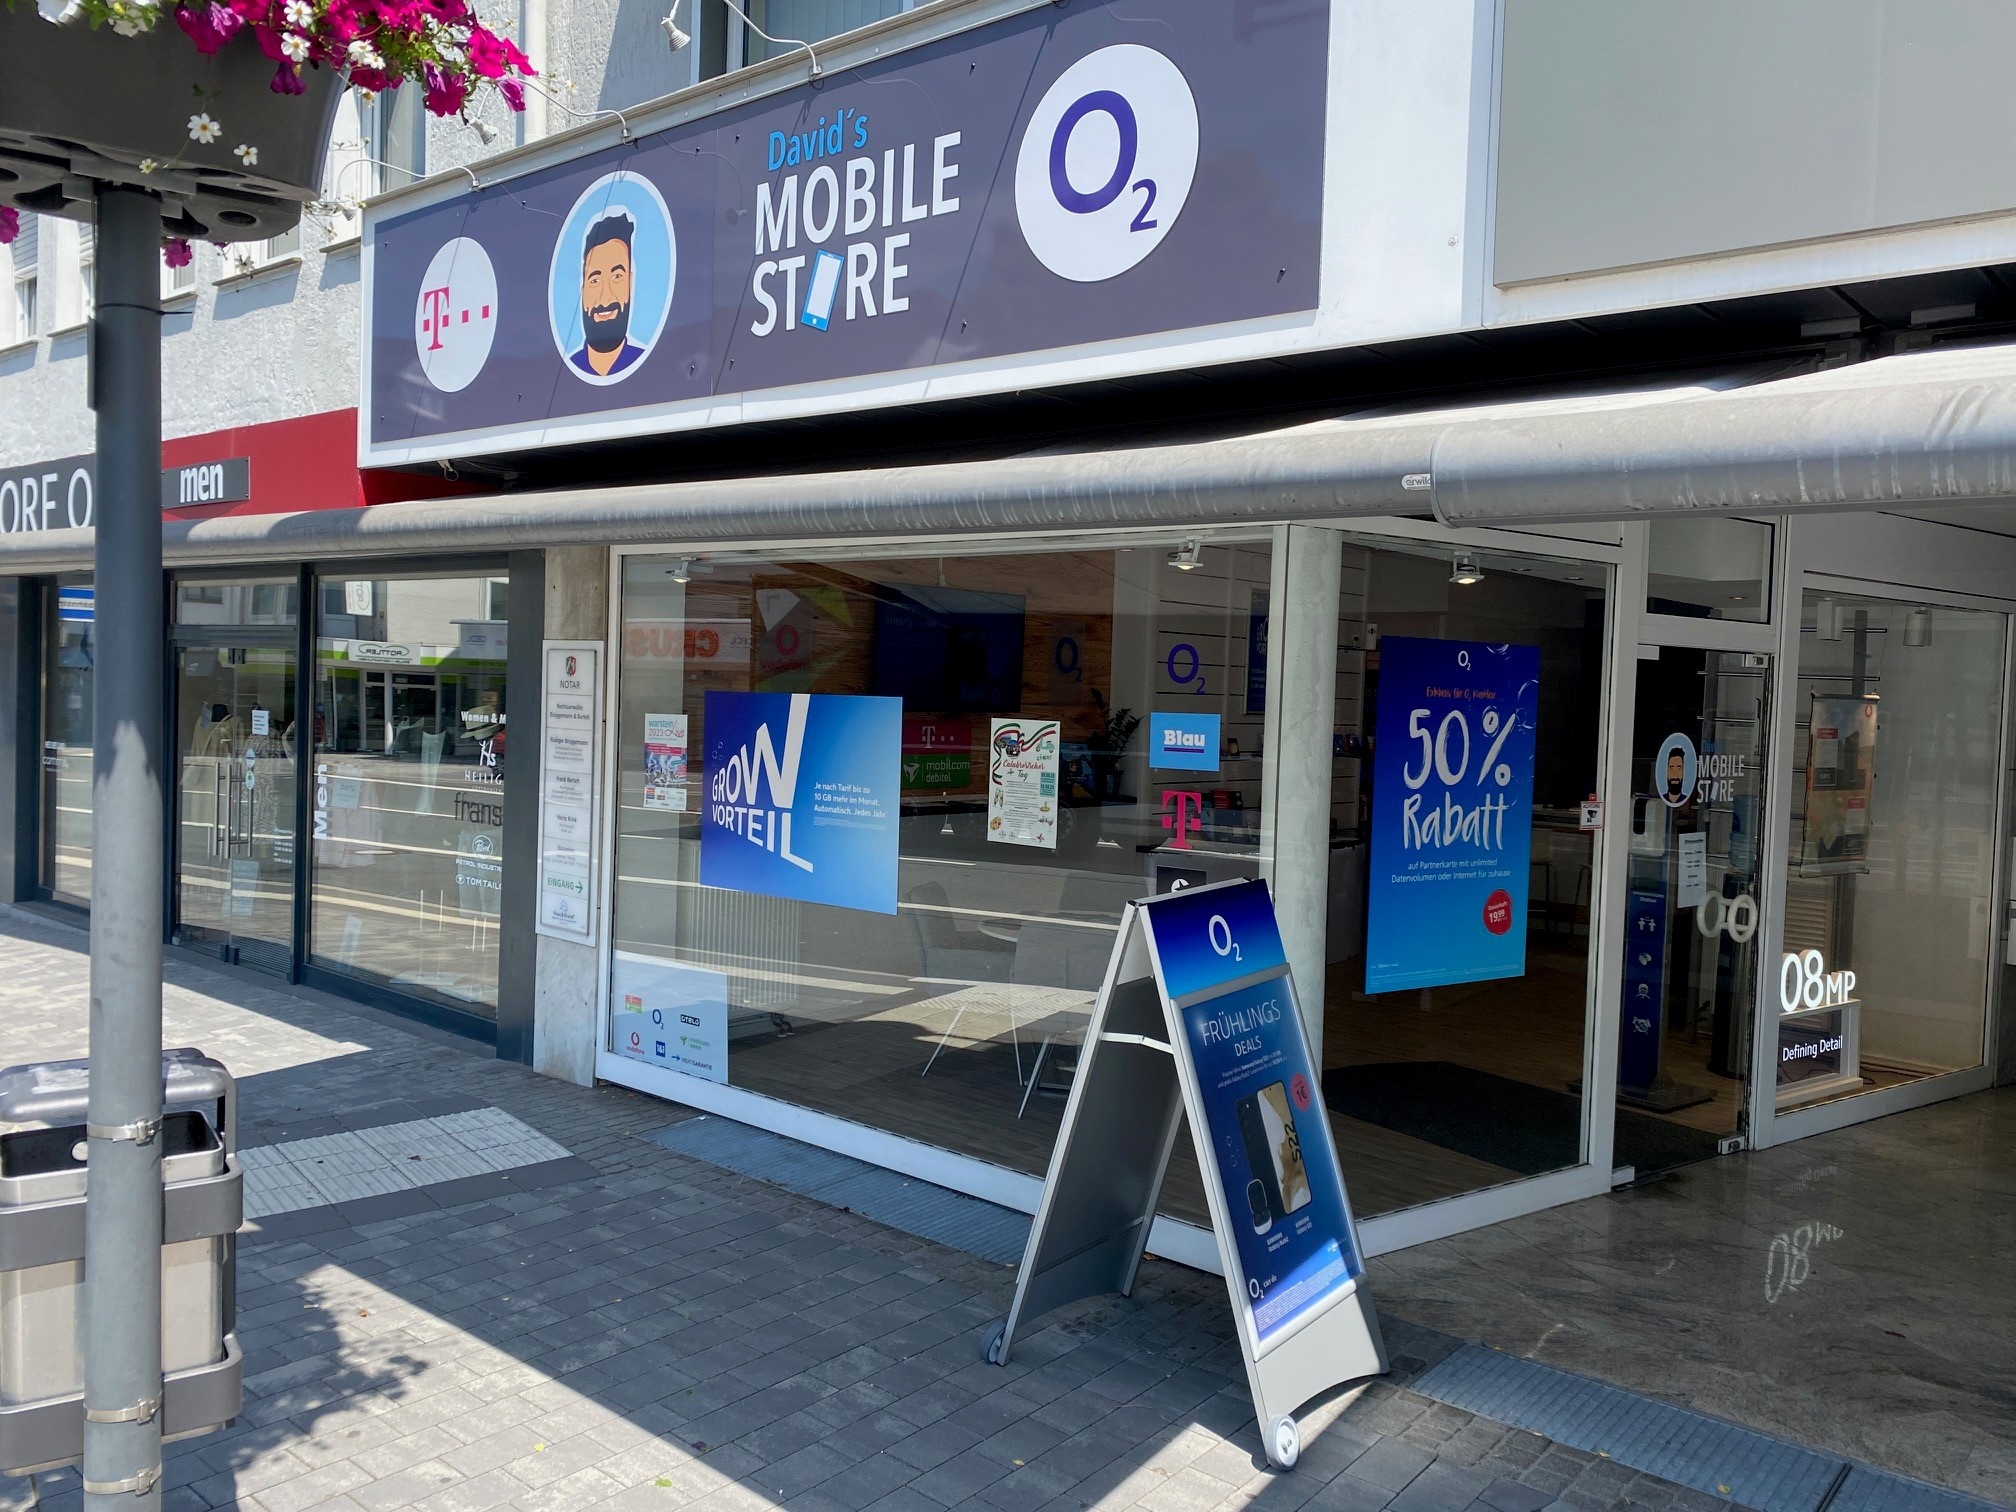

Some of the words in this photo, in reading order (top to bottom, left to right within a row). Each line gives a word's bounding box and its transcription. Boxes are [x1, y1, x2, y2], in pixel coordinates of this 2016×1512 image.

[755, 131, 962, 256] MOBILE
[180, 463, 224, 503] men
[560, 680, 580, 689] NOTAR
[461, 711, 489, 723] Women
[490, 713, 498, 723] &
[1164, 729, 1206, 748] Blau
[712, 694, 811, 809] GROW
[1403, 708, 1470, 790] 50
[925, 758, 970, 771] mobilcom
[1697, 754, 1746, 778] MOBILE
[925, 771, 952, 783] debitel
[814, 781, 821, 790] Je
[822, 783, 837, 791] nach
[838, 783, 852, 792] Tarif
[852, 785, 862, 793] bis
[312, 763, 328, 840] Men
[814, 792, 821, 801] 10
[822, 793, 832, 802] GB
[833, 795, 849, 804] mehr
[849, 796, 858, 804] im
[858, 797, 880, 806] Monat.
[813, 804, 853, 815] Automatisch.
[853, 808, 872, 817] Jedes
[1403, 791, 1510, 851] Rabatt
[712, 804, 814, 874] VORTEIL
[455, 858, 476, 868] PETROL
[1408, 861, 1418, 870] auf
[1419, 859, 1458, 870] Partnerkarte
[1470, 858, 1498, 868] unlimited
[465, 876, 482, 886] TOM
[1391, 872, 1437, 883] Datenvolumen
[1438, 872, 1452, 881] oder
[1453, 870, 1477, 880] Internet
[1478, 869, 1487, 879] für
[1488, 869, 1511, 878] zuhause
[547, 877, 575, 890] EINGANG
[1201, 999, 1281, 1047] FRÜHLINGS
[626, 1045, 645, 1055] vodafone
[1234, 1035, 1263, 1057] DEALS
[1782, 1042, 1818, 1061] Defining
[1819, 1034, 1844, 1053] Detail
